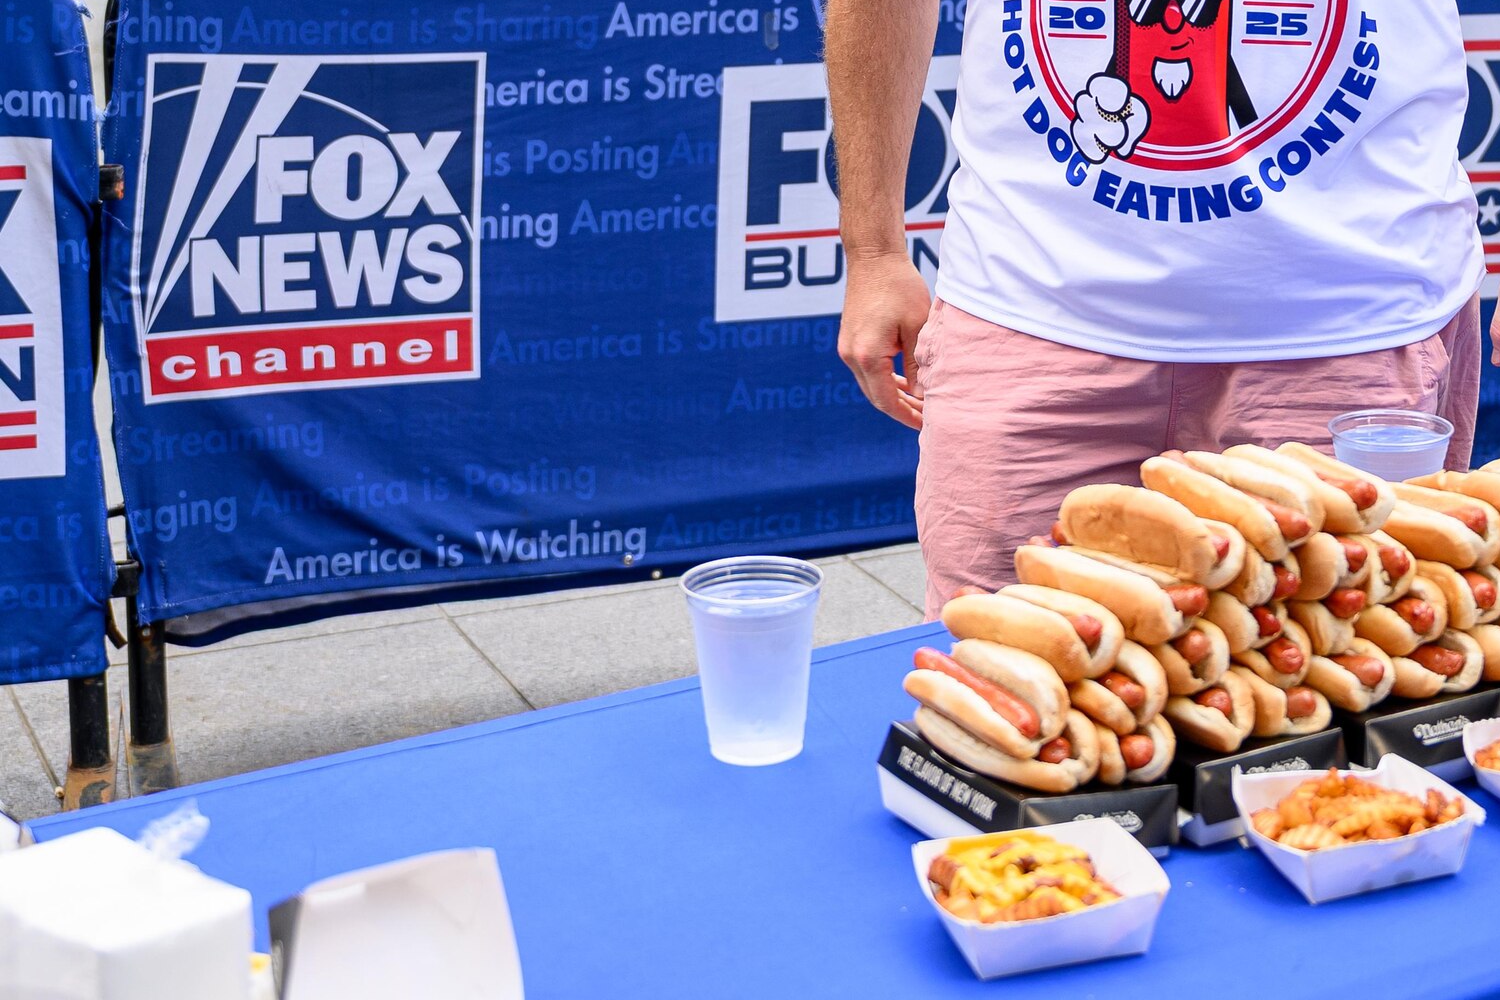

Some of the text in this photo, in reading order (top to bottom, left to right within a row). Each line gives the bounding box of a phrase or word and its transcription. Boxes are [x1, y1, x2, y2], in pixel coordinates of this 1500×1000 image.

[230, 6, 394, 45] America
[409, 6, 437, 44] is
[1048, 5, 1309, 37] 20 25
[601, 65, 631, 102] is
[642, 63, 723, 101] Stre
[1022, 96, 1090, 188] DOG
[1092, 174, 1264, 223] EATING
[1258, 10, 1380, 193] CONTEST
[254, 130, 463, 225] FOX
[525, 136, 660, 180] Posting
[190, 223, 465, 318] NEWS
[160, 329, 459, 381] channel
[487, 325, 643, 367] America
[130, 413, 325, 466] Streaming
[464, 456, 597, 499] Posting
[264, 537, 423, 585] America
[436, 533, 464, 569] is
[475, 518, 647, 564] Watching
